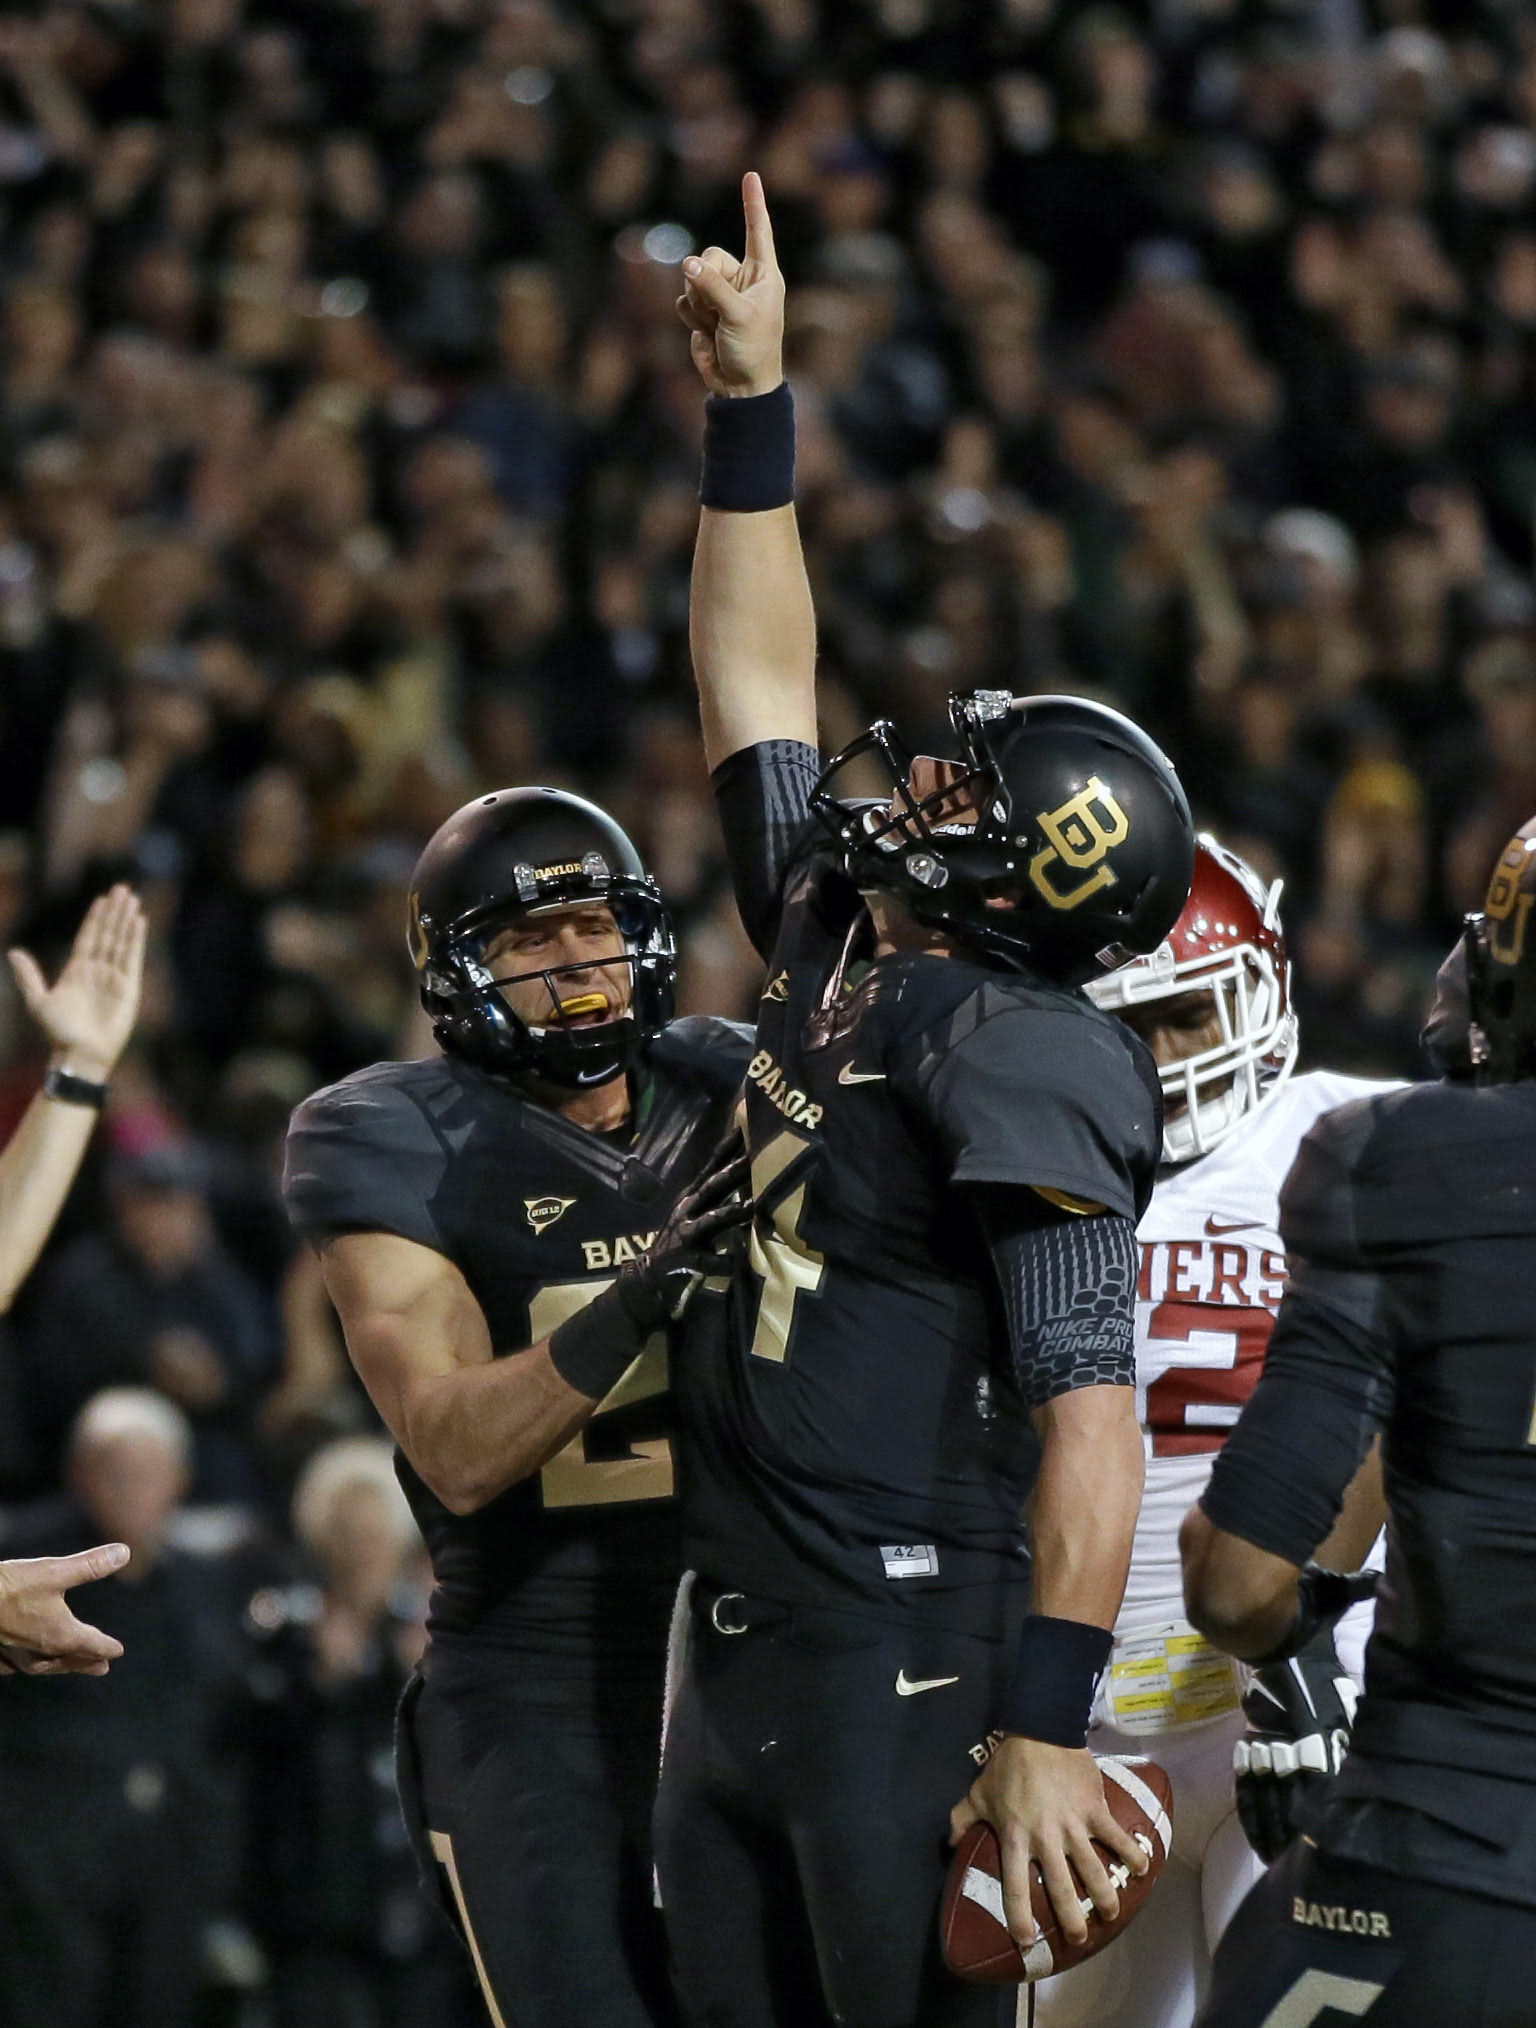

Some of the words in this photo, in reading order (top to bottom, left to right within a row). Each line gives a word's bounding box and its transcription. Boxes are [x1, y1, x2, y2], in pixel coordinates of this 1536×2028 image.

[1037, 1317, 1099, 1341] NIKE
[1098, 1317, 1133, 1340] PRO
[1038, 1334, 1131, 1359] COMBAT
[1146, 1300, 1278, 1458] 2
[893, 1545, 917, 1558] 42
[1292, 1895, 1392, 1939] BAYLOR
